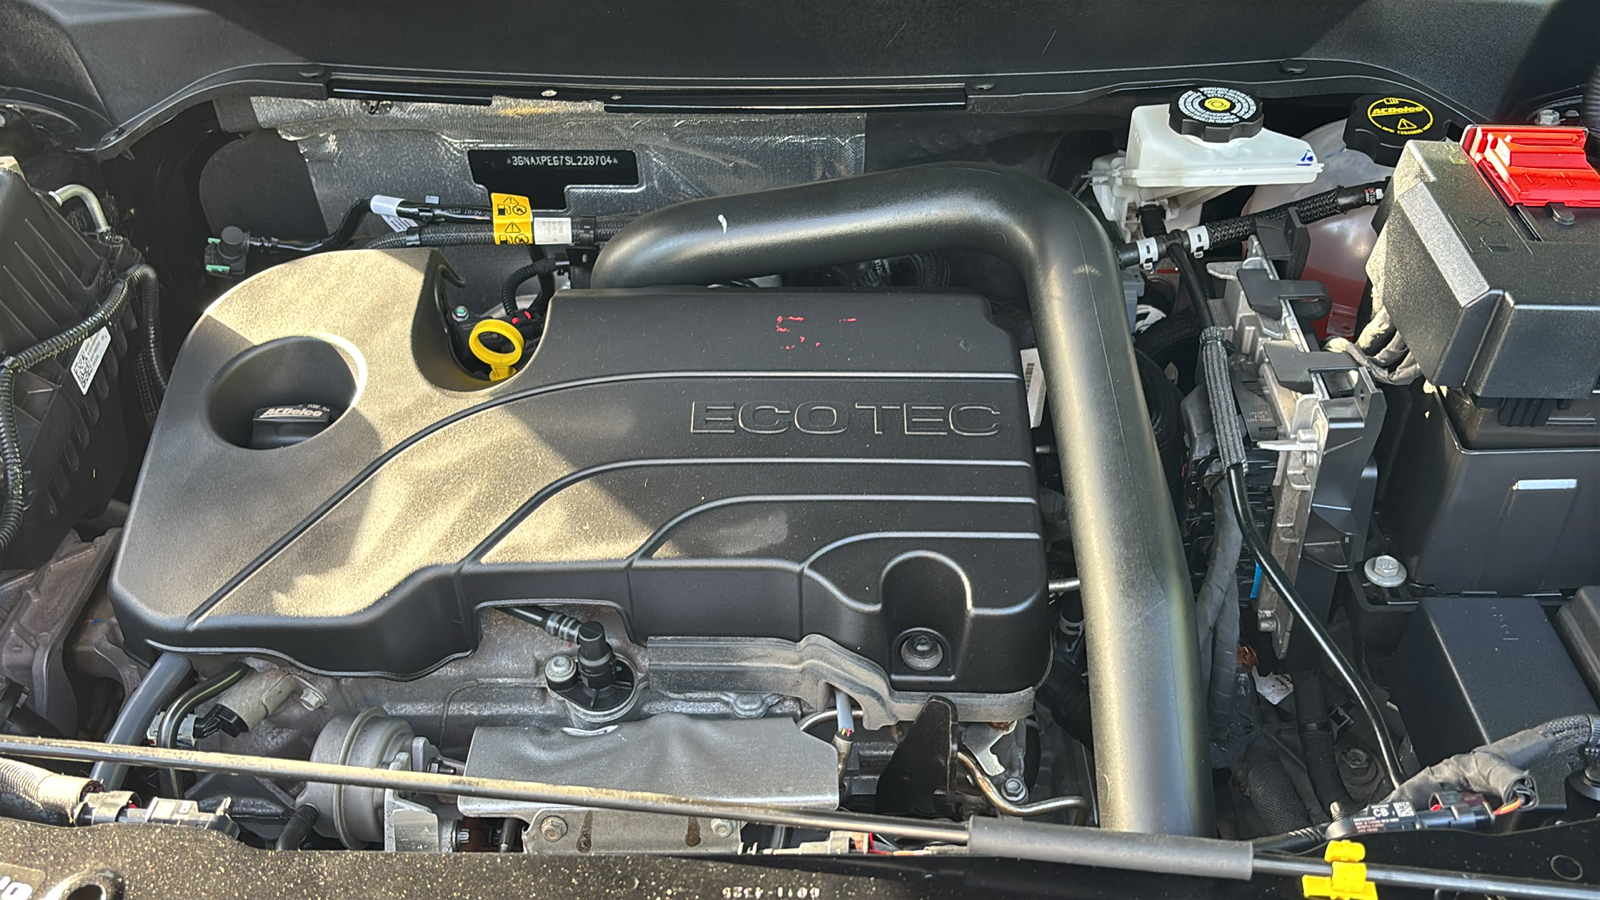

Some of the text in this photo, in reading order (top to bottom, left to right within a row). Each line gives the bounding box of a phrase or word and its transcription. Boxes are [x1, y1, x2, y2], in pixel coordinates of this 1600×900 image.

[1371, 106, 1423, 116] ACDelco
[260, 408, 323, 418] ACDelco
[690, 401, 1001, 436] ECOTEC
[1373, 808, 1389, 817] CB
